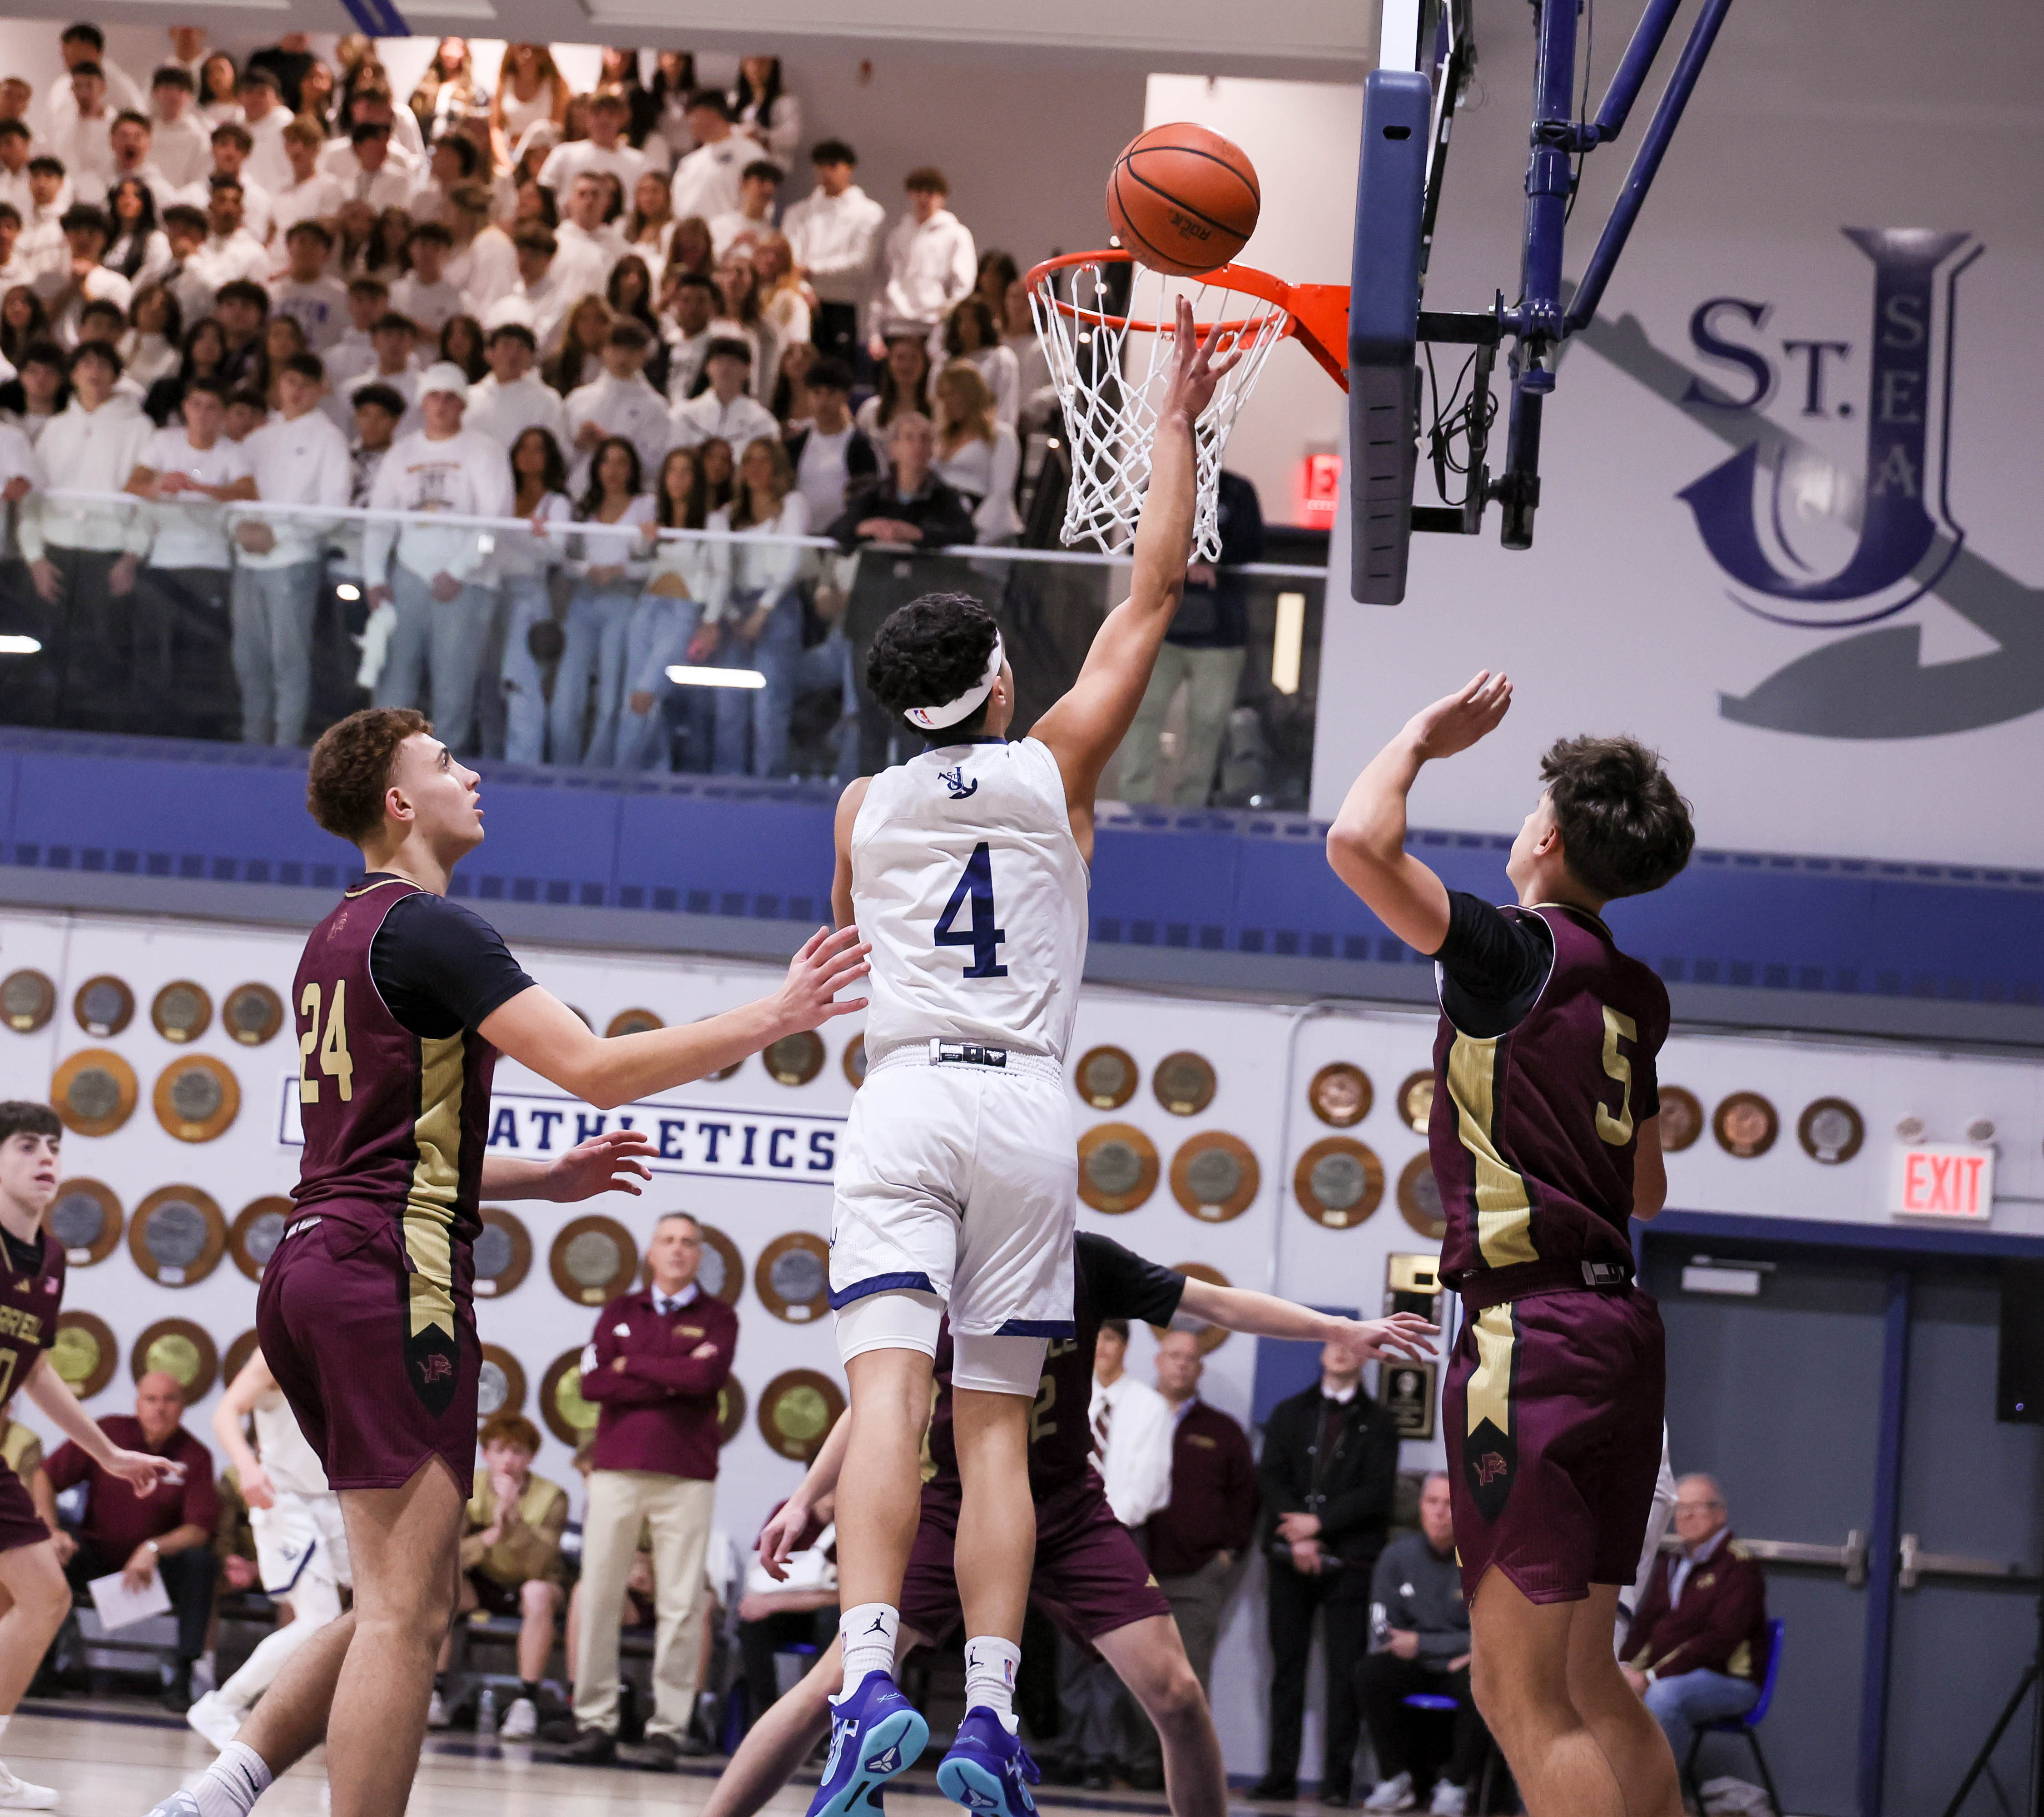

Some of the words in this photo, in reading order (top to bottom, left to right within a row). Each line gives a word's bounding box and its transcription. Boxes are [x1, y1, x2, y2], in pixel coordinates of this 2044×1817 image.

[934, 841, 1008, 978] 4
[300, 979, 353, 1103] 24
[1595, 1004, 1637, 1146] 5
[1903, 1152, 1985, 1215] EXIT
